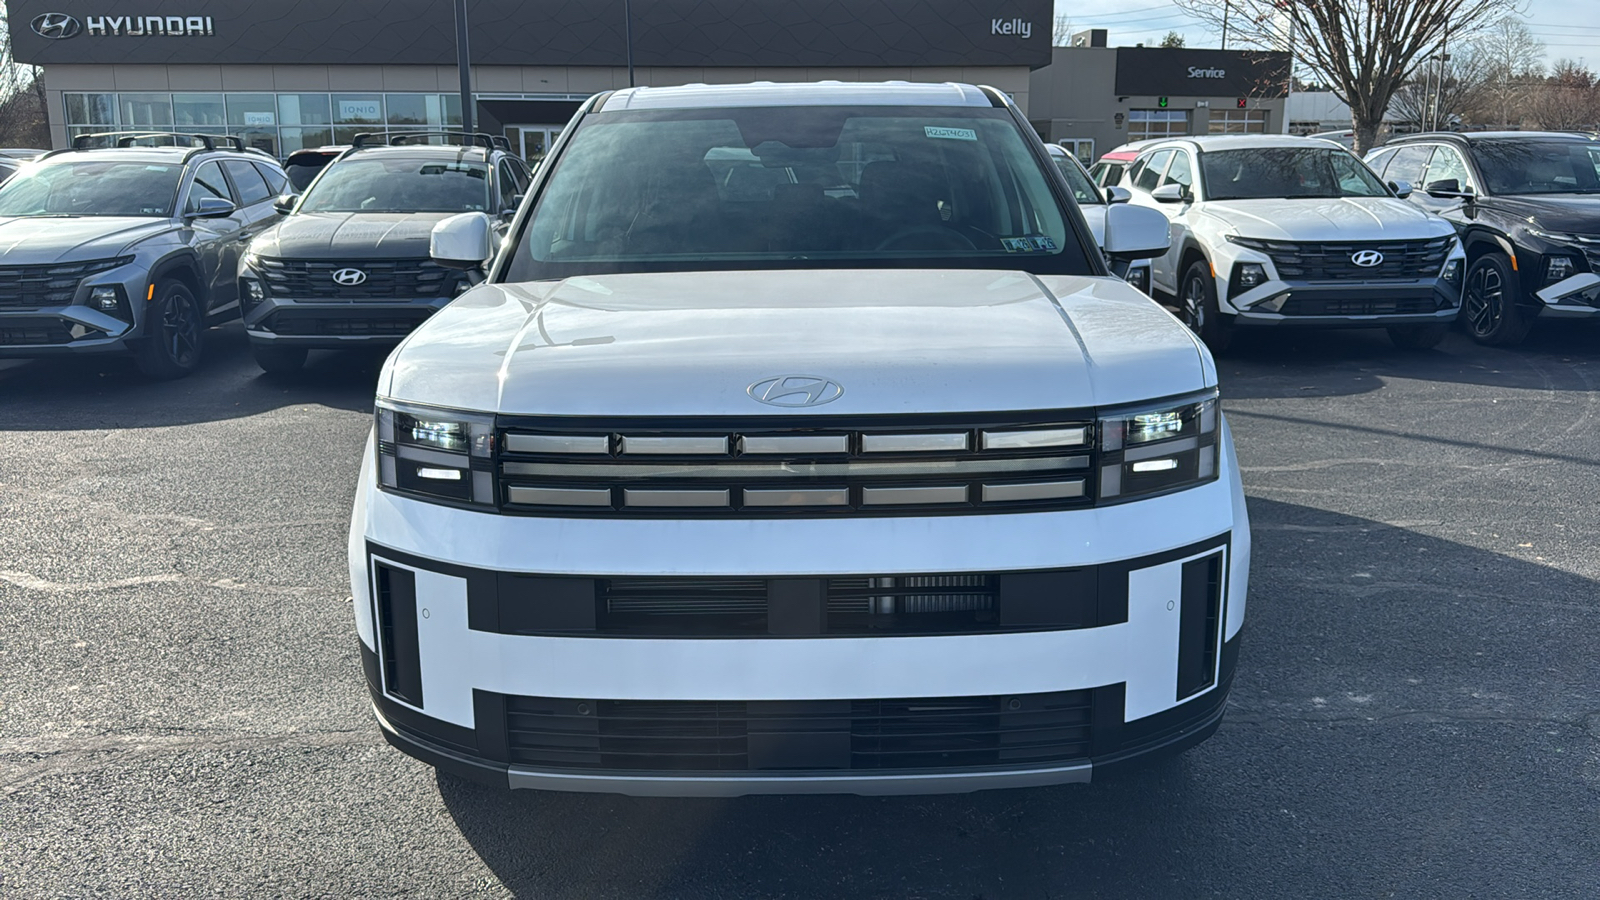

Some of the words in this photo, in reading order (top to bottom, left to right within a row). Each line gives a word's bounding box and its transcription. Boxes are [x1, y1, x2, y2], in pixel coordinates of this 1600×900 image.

[87, 16, 213, 36] HYUNDAI
[991, 18, 1031, 39] Kelly
[1187, 66, 1225, 79] Service
